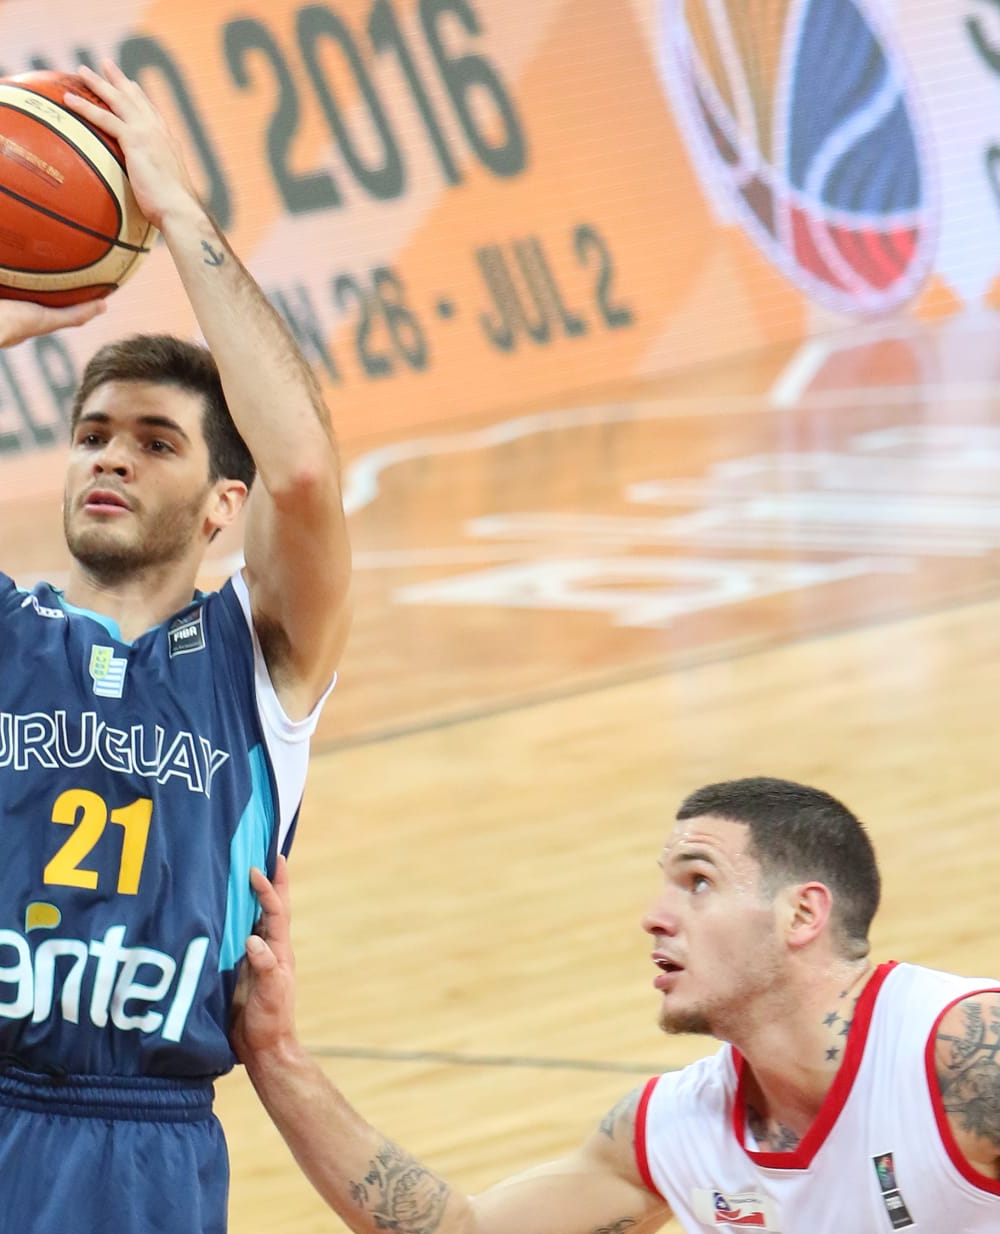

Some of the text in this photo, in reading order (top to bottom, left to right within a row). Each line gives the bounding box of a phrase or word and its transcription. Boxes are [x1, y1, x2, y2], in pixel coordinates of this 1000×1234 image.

[222, 0, 528, 216] 2016
[332, 264, 430, 379] 26
[477, 236, 588, 353] JUL
[572, 223, 633, 330] 2
[43, 788, 153, 896] 21
